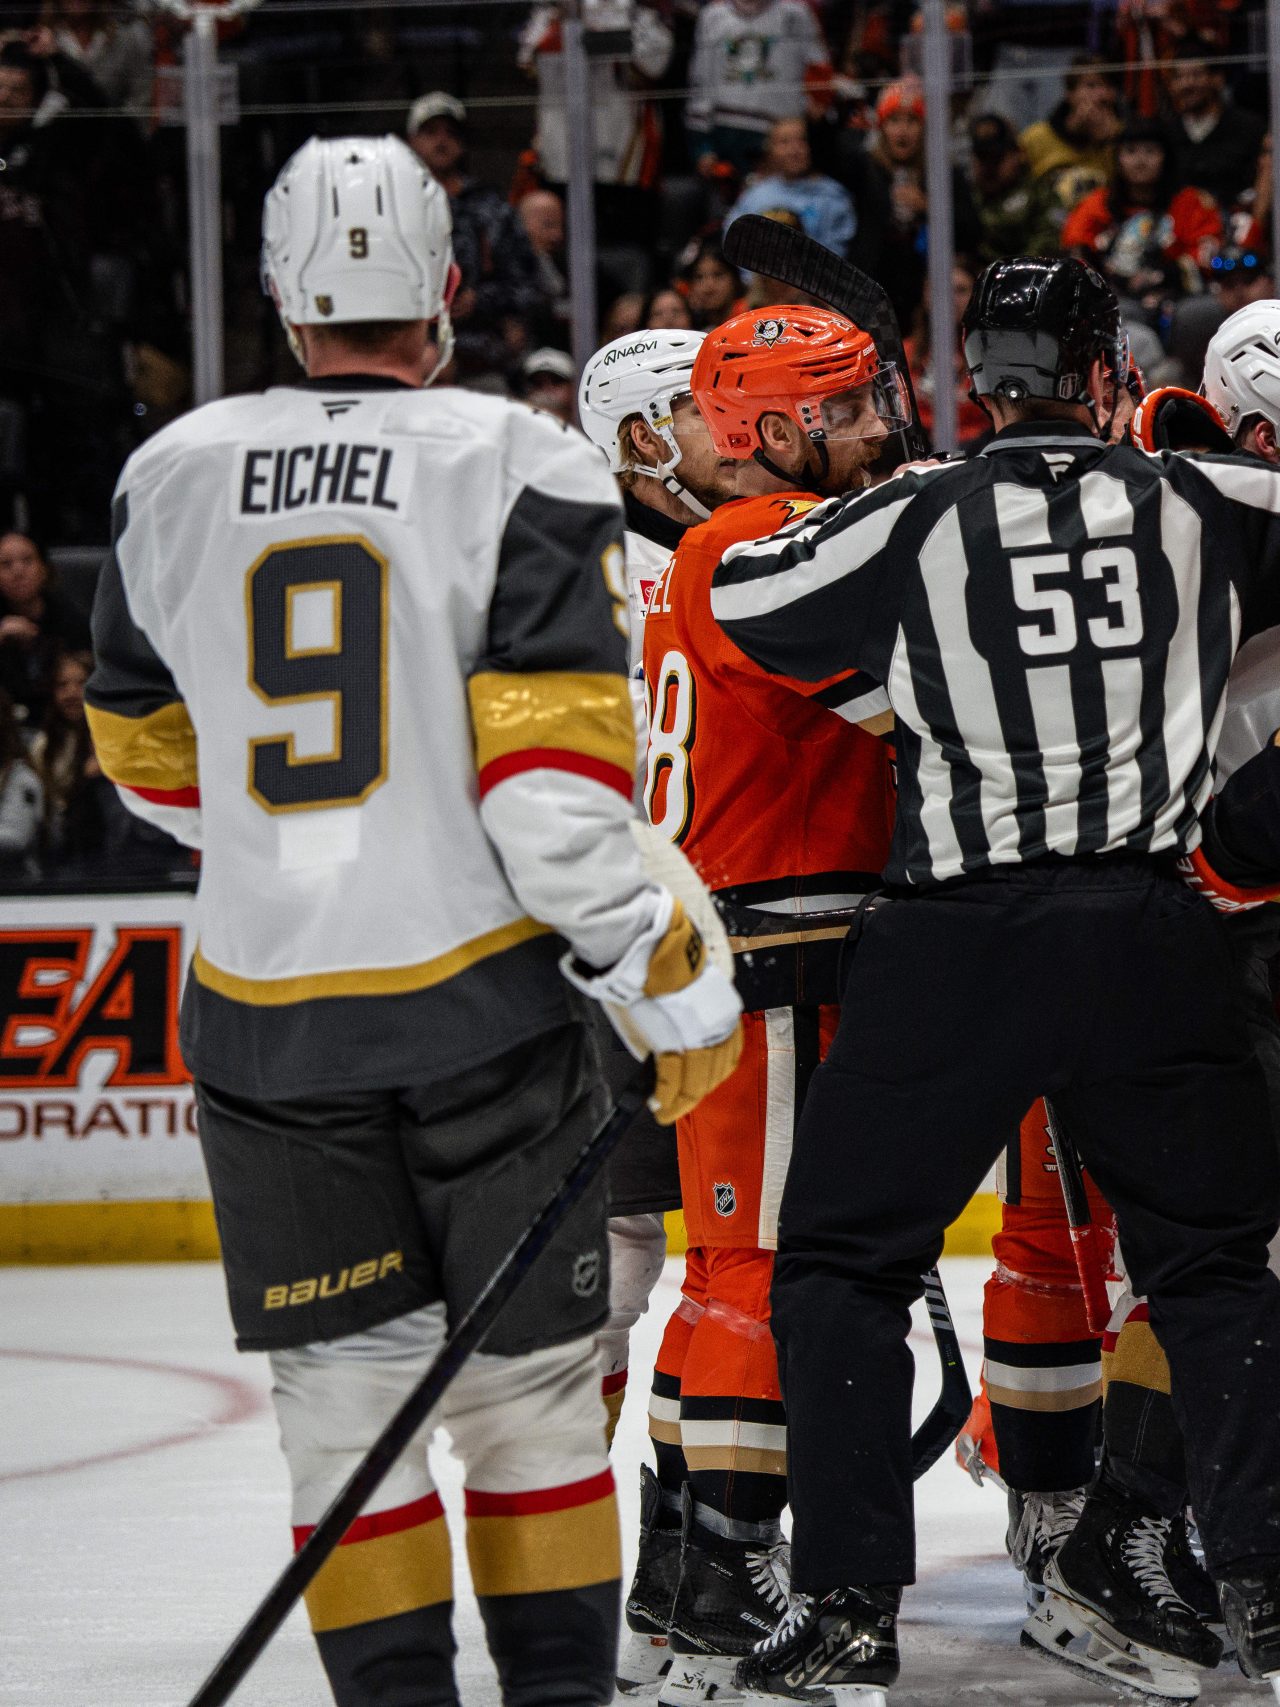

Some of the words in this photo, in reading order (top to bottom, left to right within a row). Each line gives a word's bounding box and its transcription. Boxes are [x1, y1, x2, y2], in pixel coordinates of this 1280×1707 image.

[349, 227, 369, 259] 9
[617, 341, 658, 360] NAQVI
[241, 443, 398, 515] EICHEL
[1010, 546, 1143, 656] 53
[246, 533, 389, 815] 9
[643, 650, 693, 843] 8
[264, 1250, 404, 1312] BAUER
[740, 1611, 778, 1634] BAUE
[784, 1619, 852, 1688] CCM
